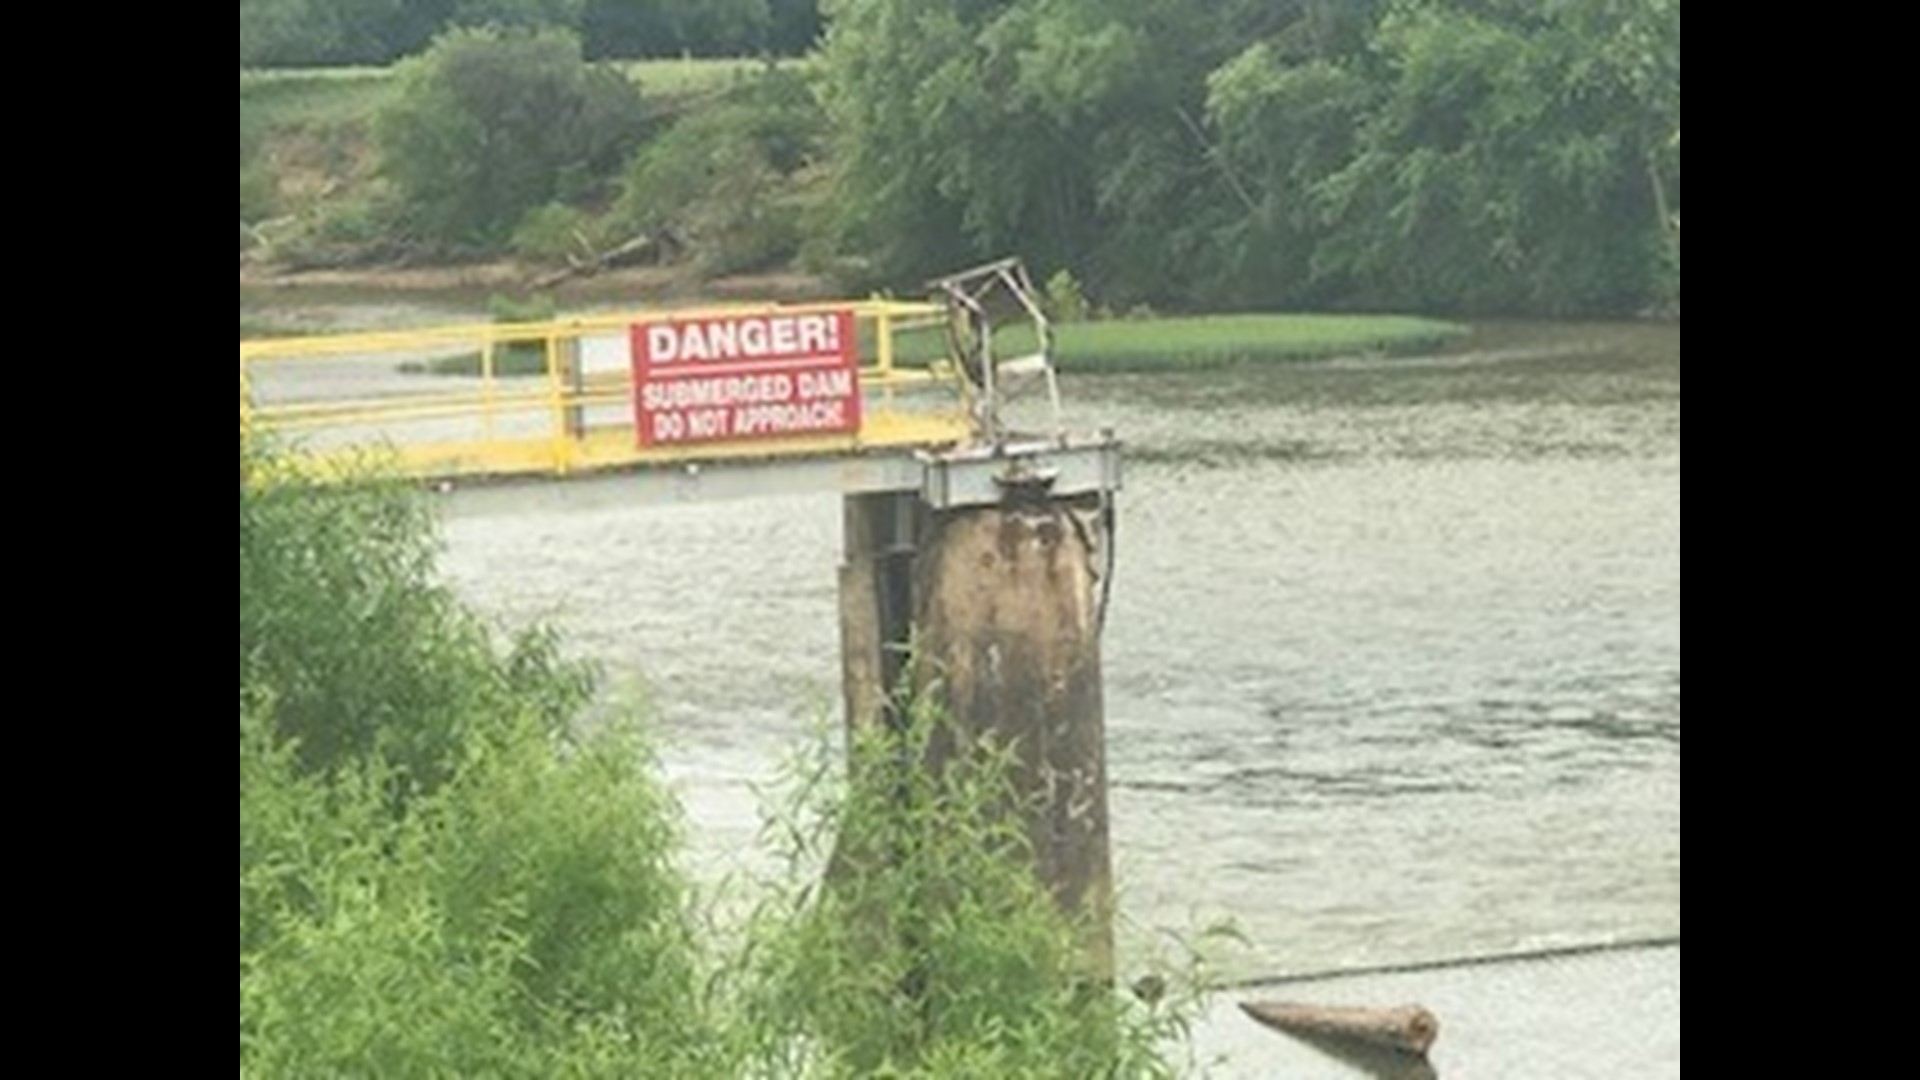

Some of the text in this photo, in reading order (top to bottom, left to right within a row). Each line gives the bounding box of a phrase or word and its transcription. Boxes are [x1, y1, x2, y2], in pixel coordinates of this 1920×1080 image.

[648, 315, 839, 363] DANGER!
[642, 369, 852, 411] SUBMERGED DAM
[653, 412, 685, 440] DO
[687, 408, 729, 437] NOT
